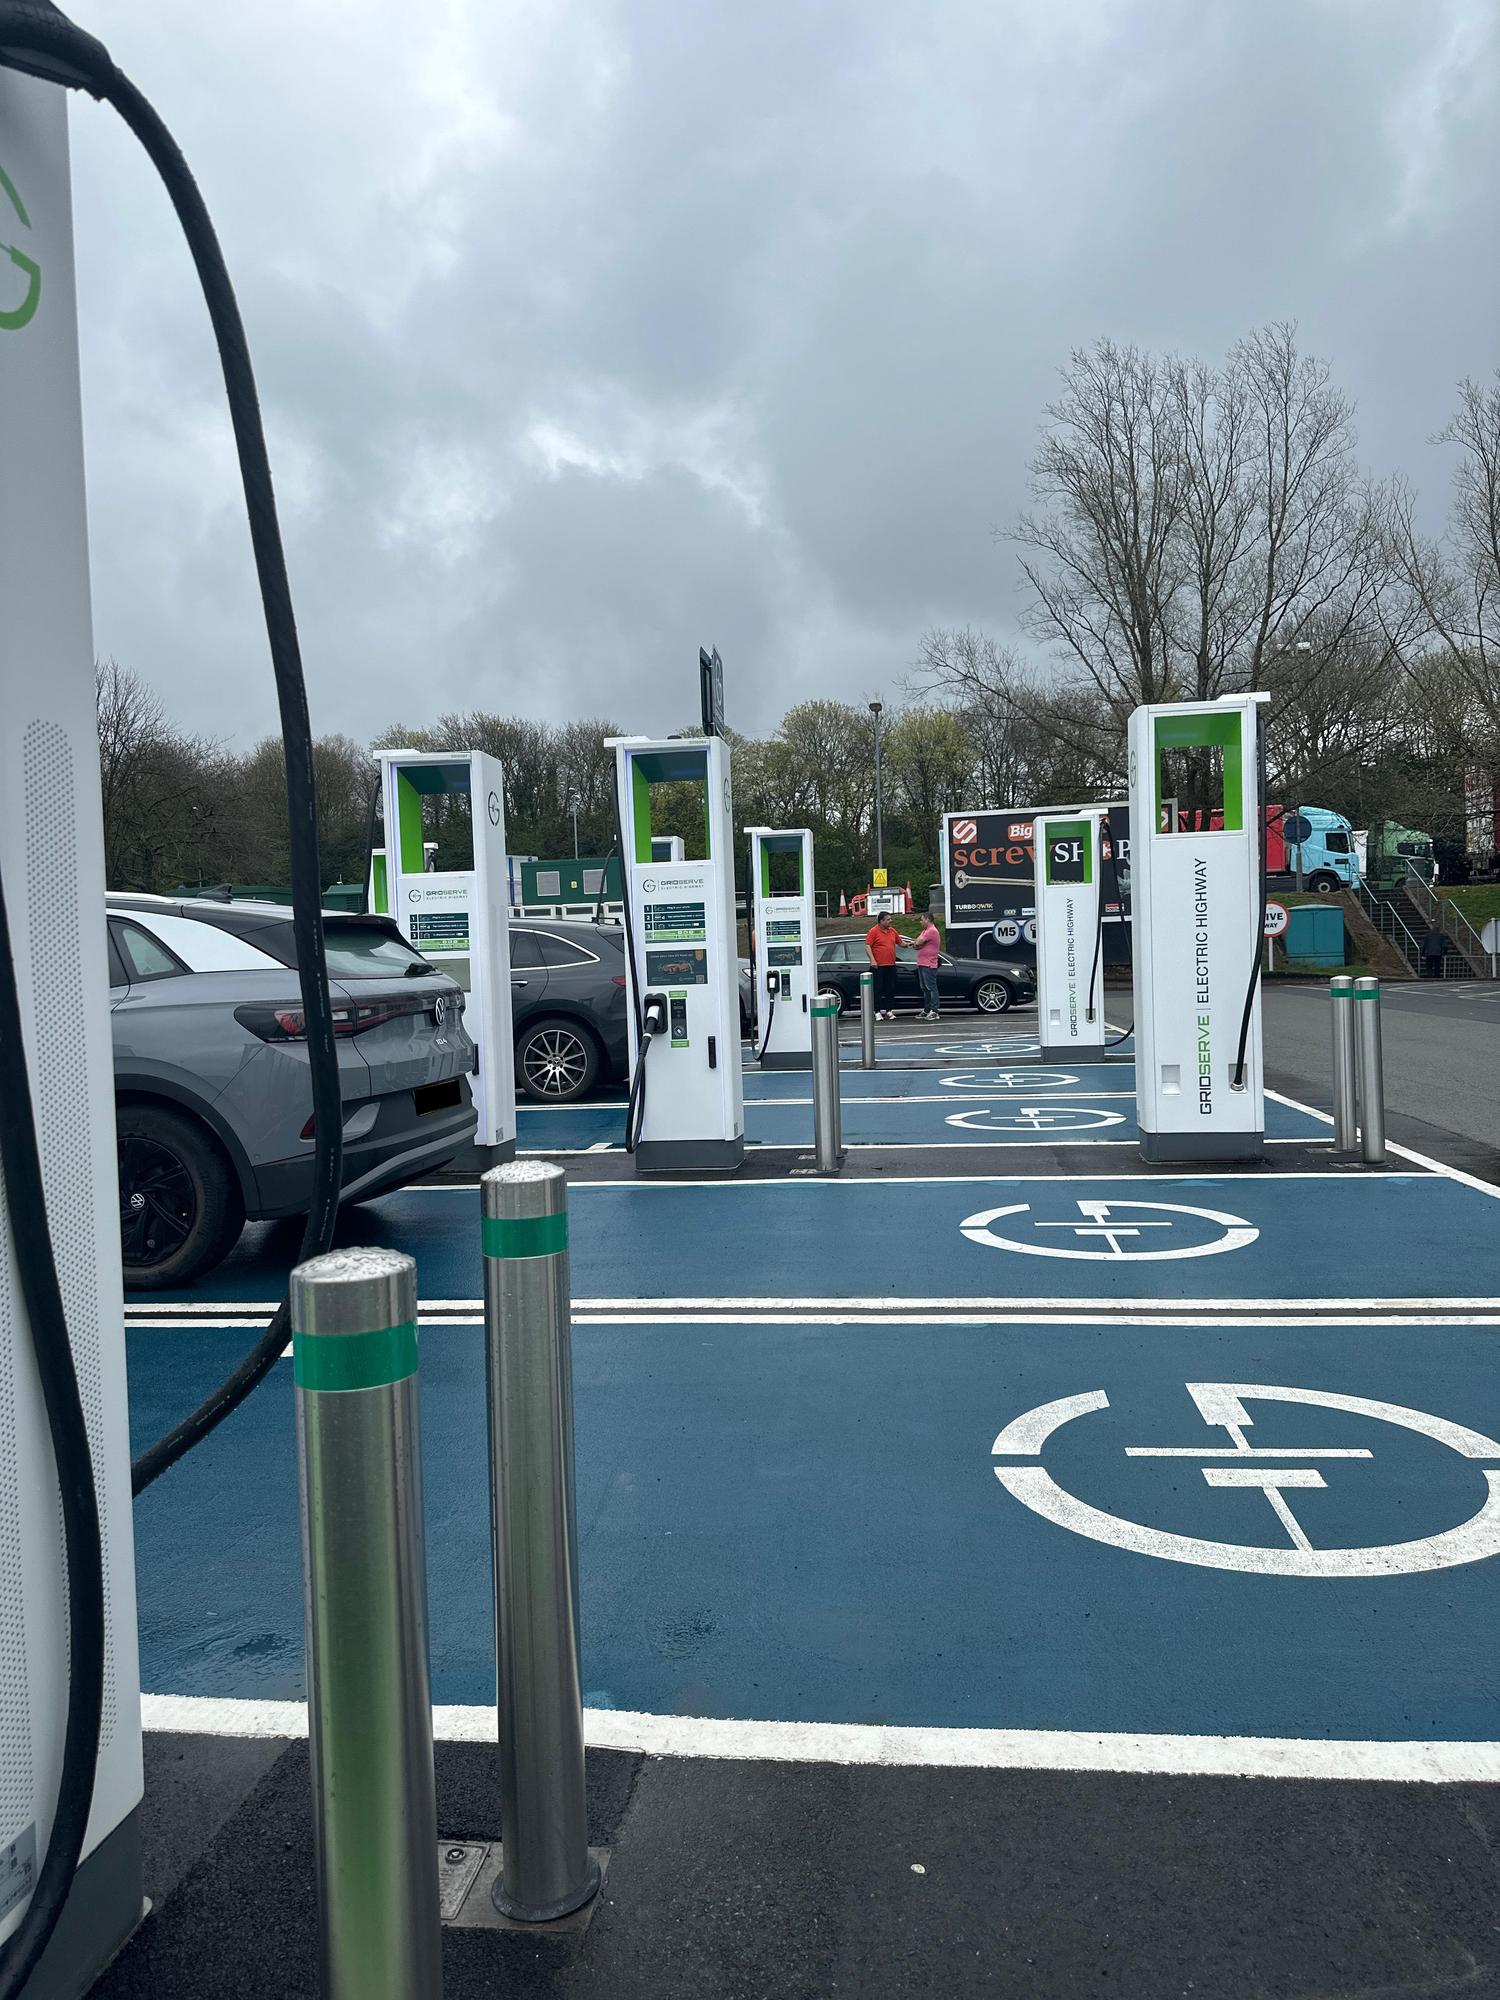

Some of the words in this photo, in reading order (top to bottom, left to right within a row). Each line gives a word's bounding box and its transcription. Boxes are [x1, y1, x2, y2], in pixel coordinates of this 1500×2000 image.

[1010, 825, 1033, 839] Big
[1194, 858, 1208, 928] HIGHWAY
[997, 927, 1017, 937] M5
[1066, 897, 1075, 936] HIGHWAY
[1266, 912, 1284, 921] IVE
[1067, 937, 1076, 977] ELECTRIC
[1196, 932, 1209, 1004] ELECTRIC
[1068, 982, 1078, 1037] GRIDSERVE
[1198, 1015, 1212, 1115] GRIDSERVE
